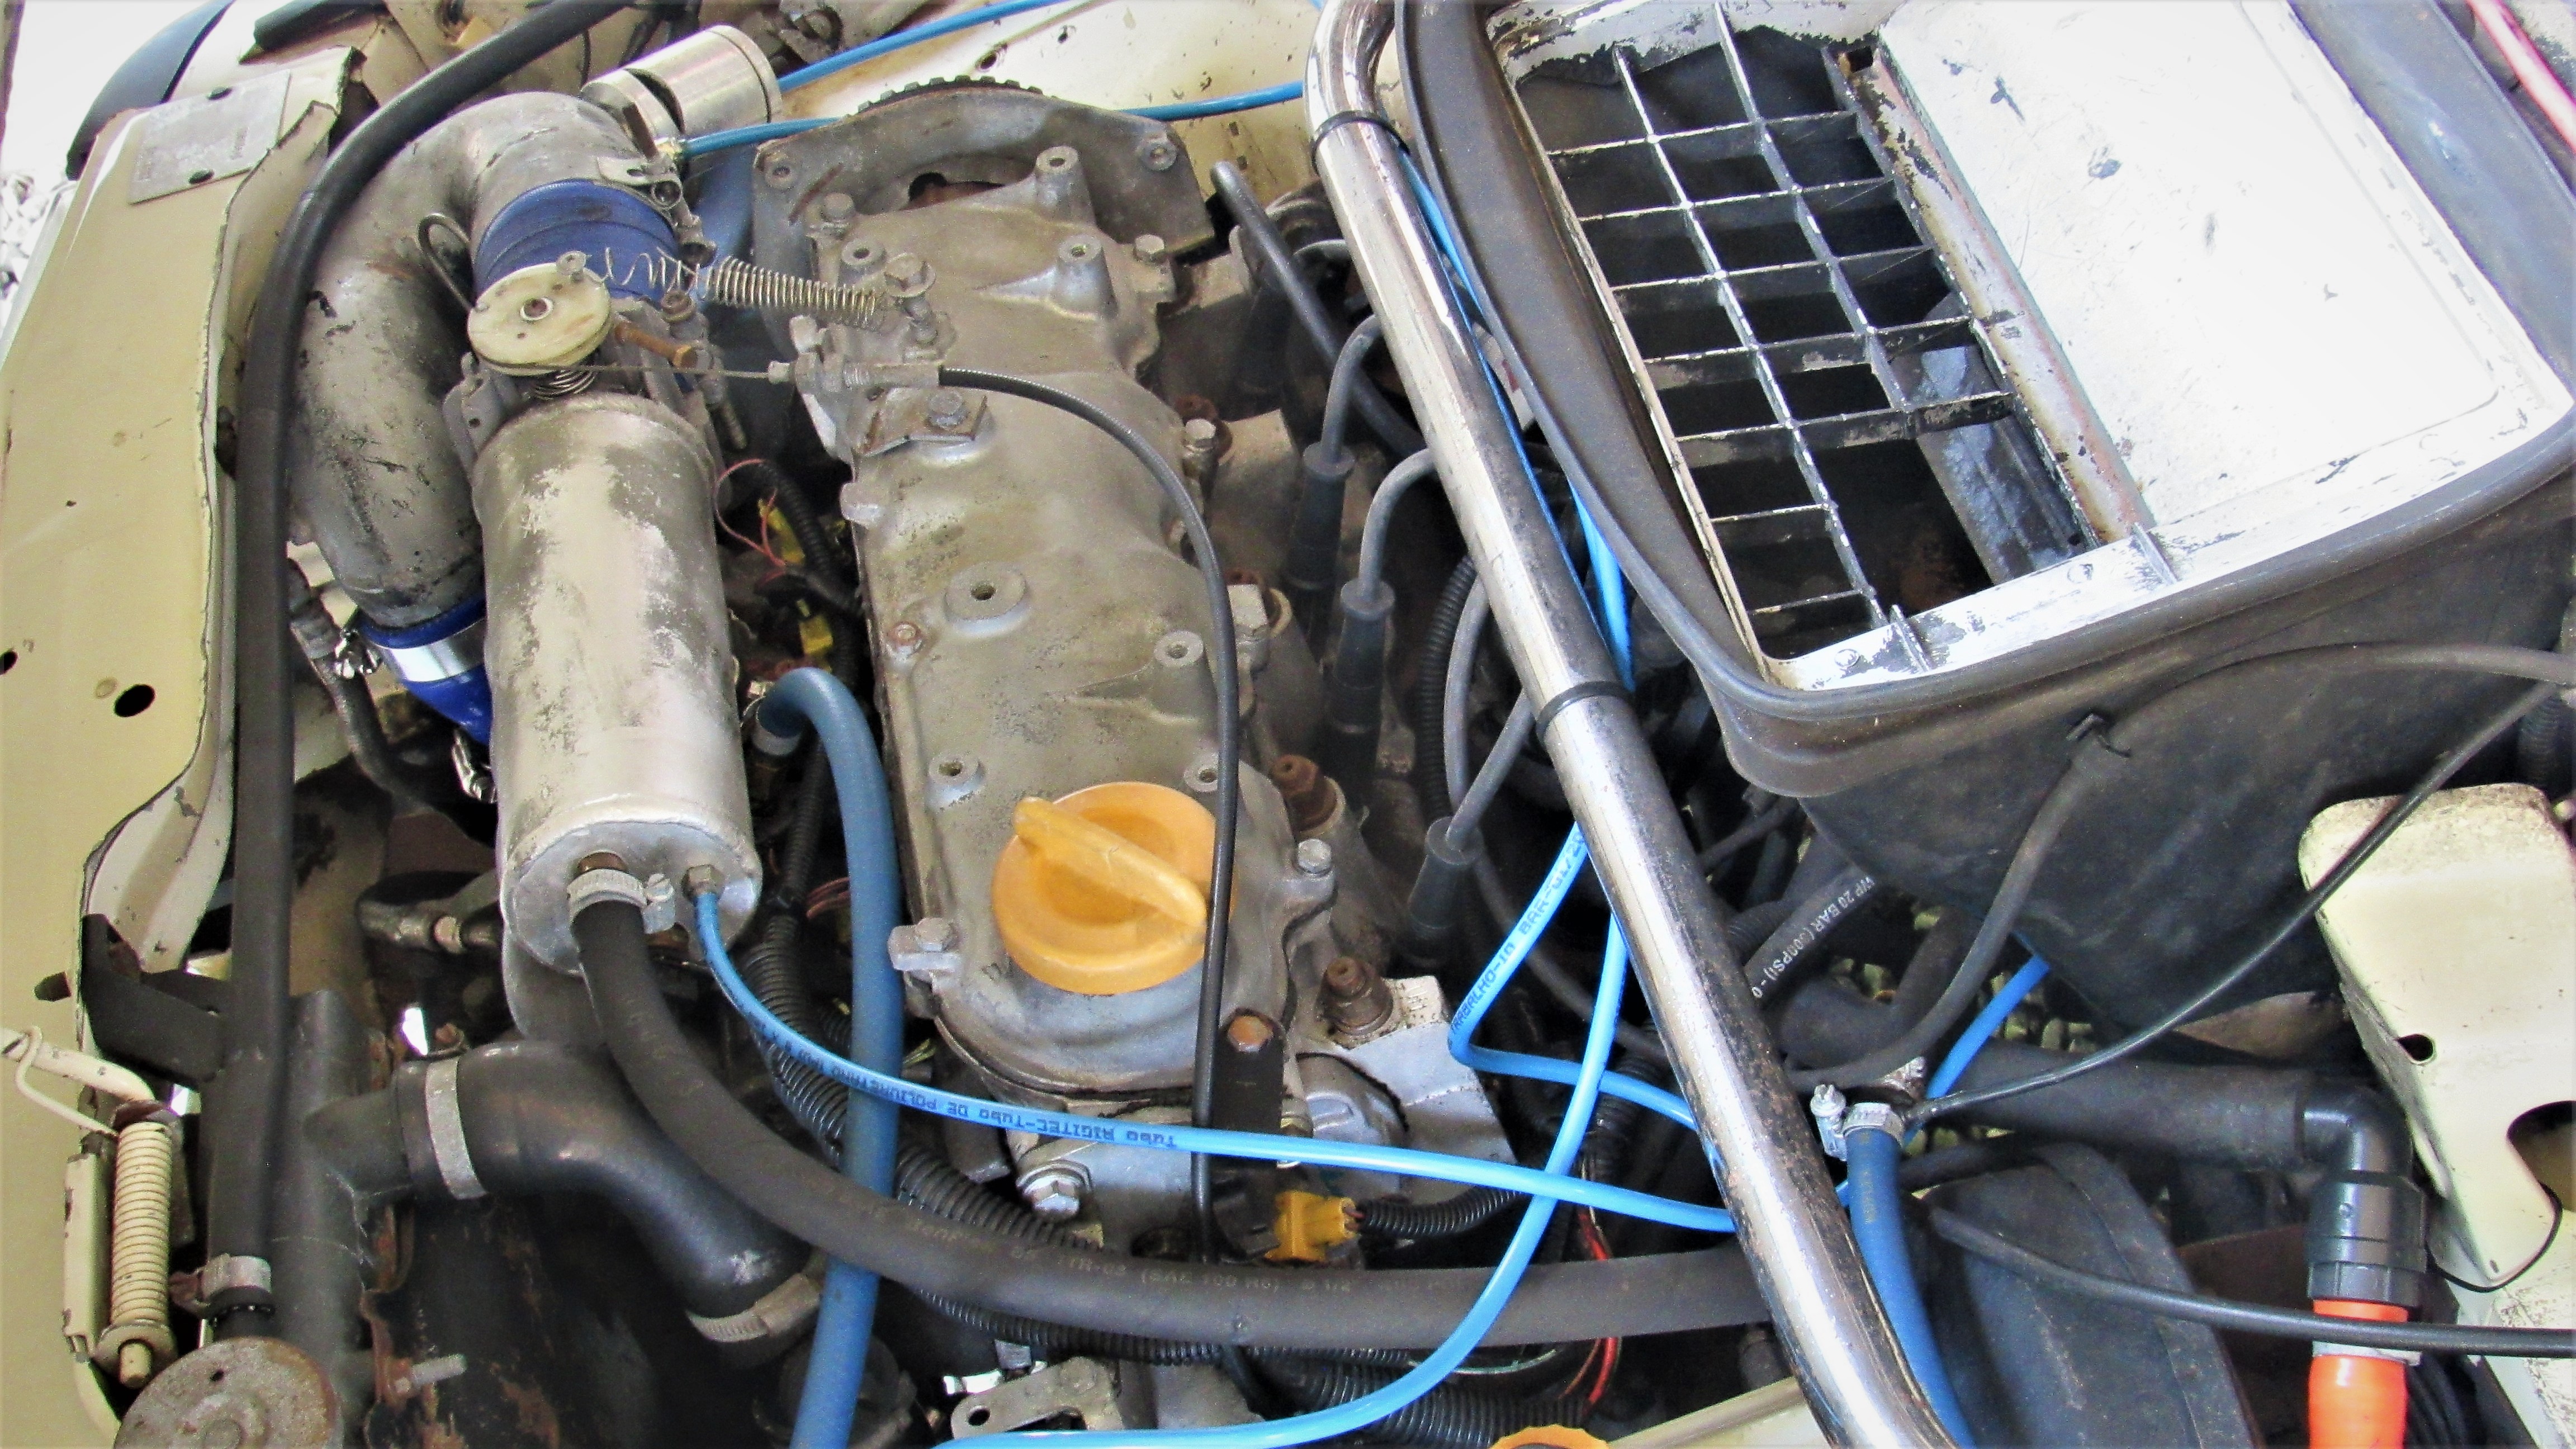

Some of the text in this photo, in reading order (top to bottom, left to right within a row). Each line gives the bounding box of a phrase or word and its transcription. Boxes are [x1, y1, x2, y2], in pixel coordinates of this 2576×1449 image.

[1810, 903, 1841, 932] BAR
[946, 1102, 969, 1118] DE
[1126, 1130, 1178, 1149] Tubo
